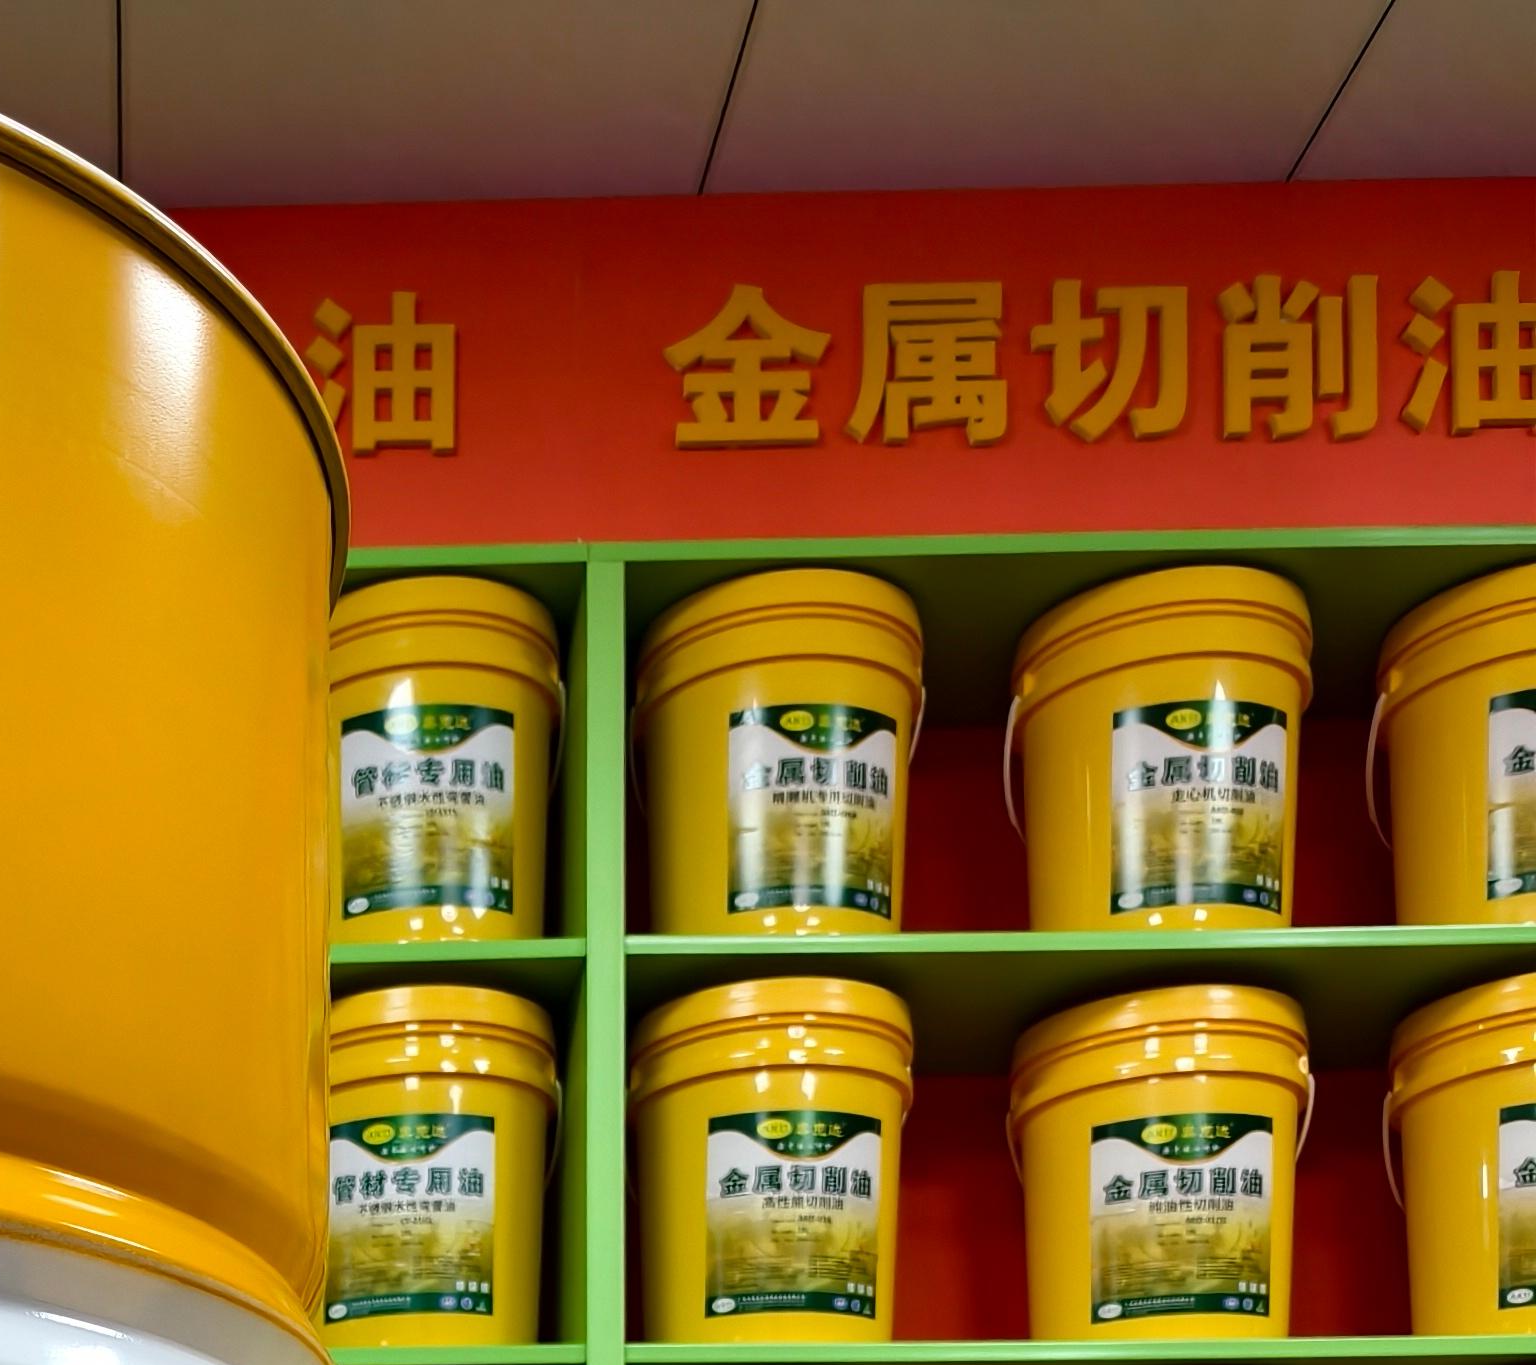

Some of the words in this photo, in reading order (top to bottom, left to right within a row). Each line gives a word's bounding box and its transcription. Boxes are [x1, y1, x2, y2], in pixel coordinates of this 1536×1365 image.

[718, 1164, 872, 1199] 金属切削油
[1103, 1167, 1263, 1206] 金属切削油
